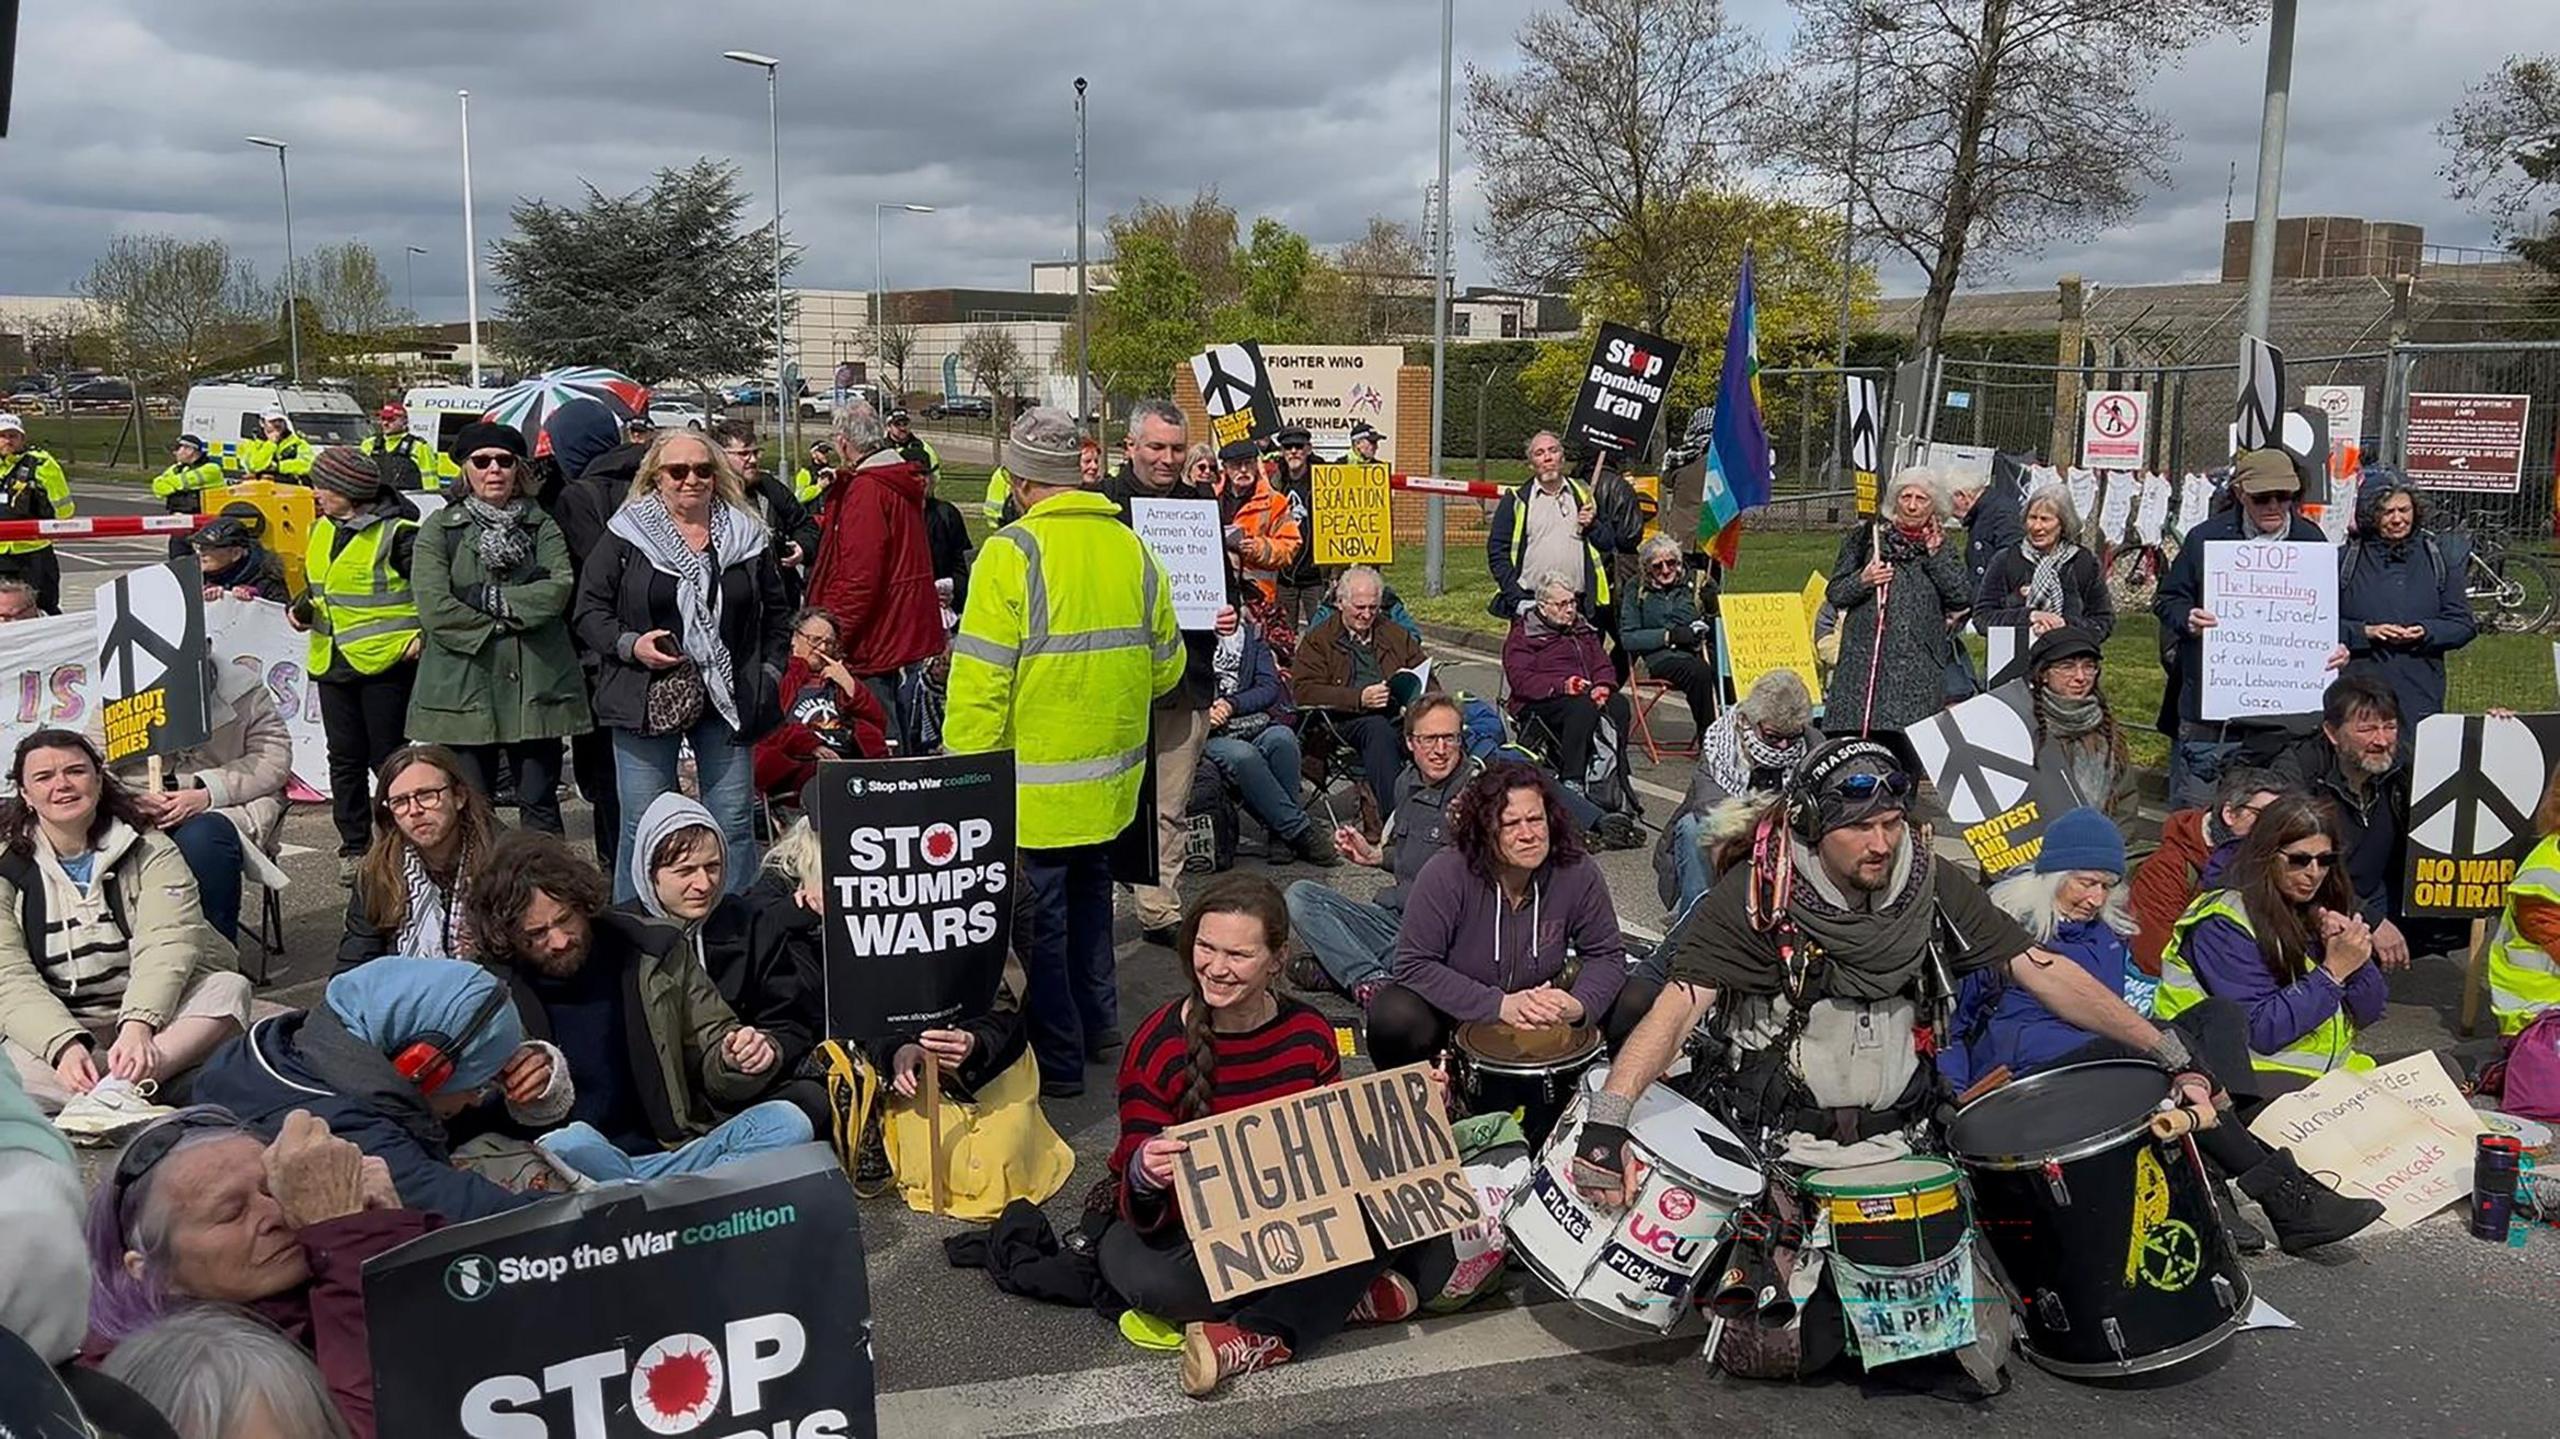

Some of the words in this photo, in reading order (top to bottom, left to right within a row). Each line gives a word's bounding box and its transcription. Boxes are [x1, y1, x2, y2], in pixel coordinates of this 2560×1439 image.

[1268, 356, 1324, 368] FIGHTER
[1330, 356, 1364, 368] WING
[1606, 339, 1663, 378] Stop
[1292, 380, 1314, 390] THE
[1589, 364, 1662, 404] Bombing
[1313, 398, 1341, 408] WING
[1594, 386, 1643, 420] Iran
[2406, 447, 2433, 456] CCTV
[2433, 448, 2481, 457] CAMERAS
[1314, 466, 1342, 487] NO
[1359, 465, 1386, 487] TO
[1314, 487, 1385, 510] ESCALATION
[1146, 508, 1206, 520] American
[1320, 513, 1381, 535] PEACE
[1141, 525, 1187, 537] Airmen
[1189, 526, 1214, 538] You
[1151, 542, 1184, 555] Have
[1187, 543, 1208, 555] the
[1328, 536, 1380, 557] NOW
[2234, 545, 2299, 569] STOP
[1170, 572, 1191, 587] ght
[1194, 573, 1206, 584] to
[2213, 571, 2244, 593] The
[2250, 574, 2317, 605] bombing
[1194, 590, 1220, 601] War
[1733, 598, 1758, 613] No
[1762, 596, 1785, 612] US
[2210, 629, 2253, 644] mass
[2260, 632, 2330, 651] murderers
[2210, 649, 2227, 665] of
[2233, 651, 2288, 668] civilians
[2294, 659, 2305, 669] in
[2245, 671, 2298, 689] Lebanon
[2300, 677, 2325, 690] and
[105, 695, 134, 723] KICK
[132, 688, 166, 714] OUT
[2239, 691, 2283, 709] Gaza
[106, 706, 167, 739] TRUMP'S
[1828, 755, 1841, 768] A
[868, 778, 898, 794] Stop
[898, 778, 918, 791] the
[919, 777, 943, 790] War
[944, 771, 992, 788] coalition
[1963, 801, 2040, 846] PROTEST
[849, 818, 993, 871] STOP
[1974, 835, 2011, 860] AND
[1982, 836, 2045, 874] SURVIV
[2416, 858, 2456, 883] NO
[2459, 859, 2516, 883] WAR
[833, 861, 1007, 908] TRUMP'S
[2415, 882, 2453, 907] ON
[844, 900, 998, 957] WARS
[1177, 1089, 1350, 1230] FIGHT
[1337, 1072, 1455, 1182] WAR
[1209, 1206, 1340, 1292] NOT
[1362, 1170, 1481, 1246] WARS
[498, 1255, 568, 1286] Stop
[572, 1242, 619, 1273] the
[621, 1225, 678, 1259] War
[681, 1202, 797, 1247] coalition
[1608, 1249, 1671, 1292] Picket
[1856, 1280, 1897, 1302] WE
[459, 1312, 807, 1439] STOP
